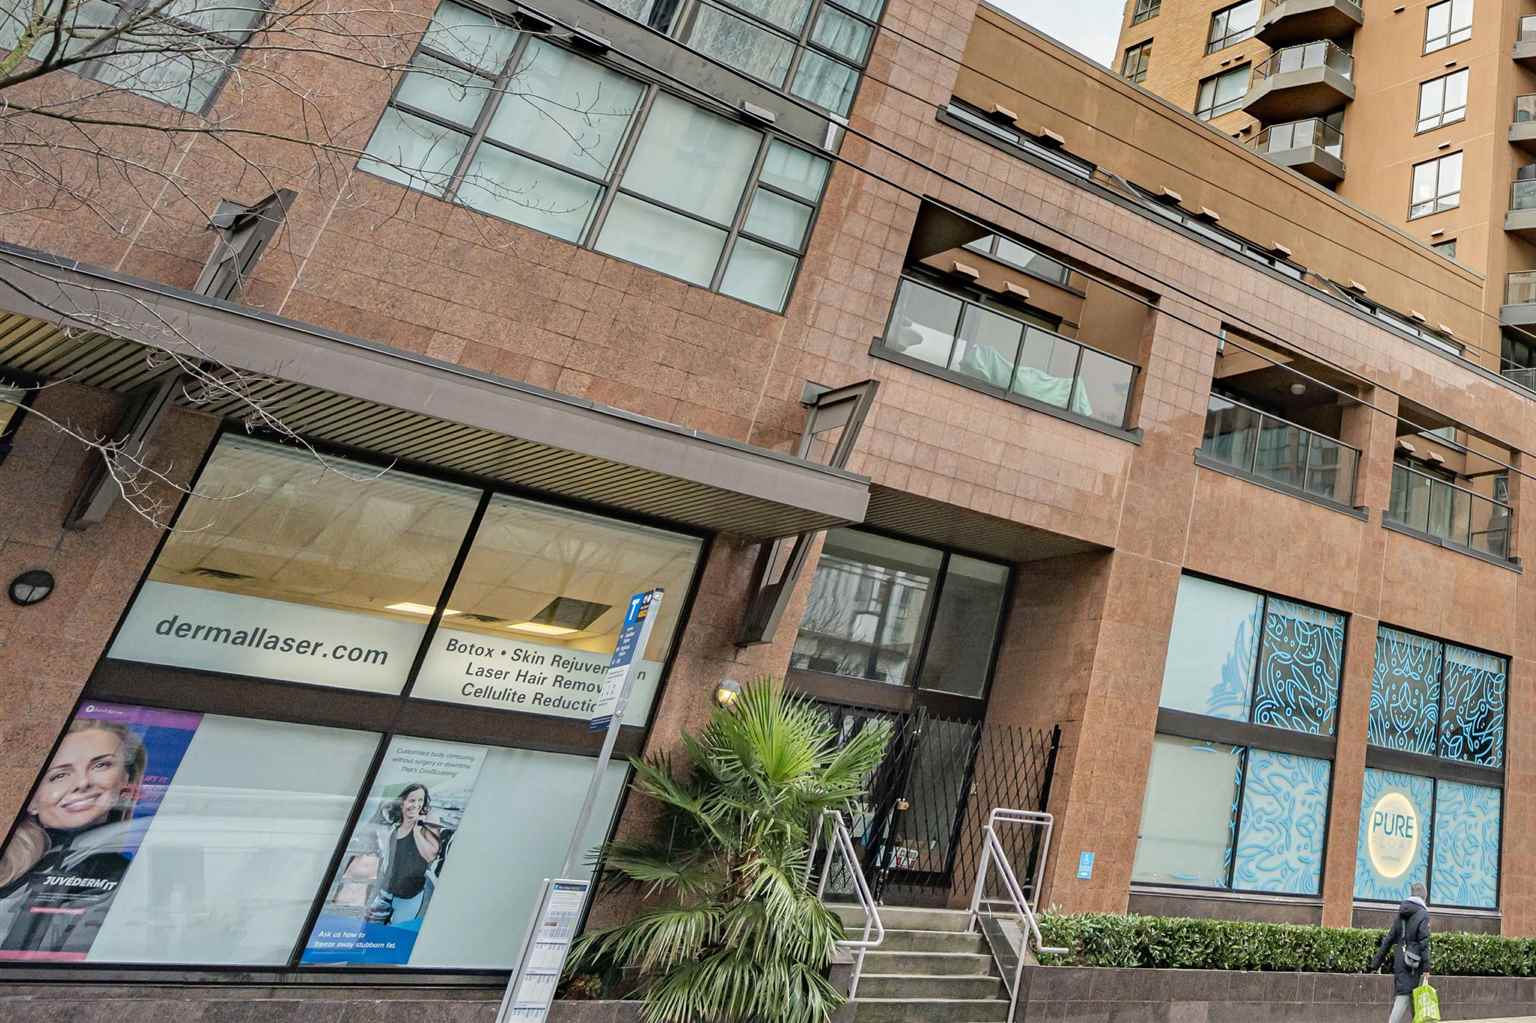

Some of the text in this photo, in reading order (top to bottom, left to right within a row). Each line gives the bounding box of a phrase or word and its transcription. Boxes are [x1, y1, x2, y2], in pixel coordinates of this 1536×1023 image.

[155, 615, 389, 665] dermallaser.com
[446, 638, 495, 658] Botox
[511, 648, 545, 665] Skin
[465, 662, 602, 694] Laser Hair Remov
[461, 683, 526, 704] Cellulite
[1372, 811, 1415, 839] PURE
[318, 930, 331, 938] Ask
[355, 941, 385, 949] stubborn
